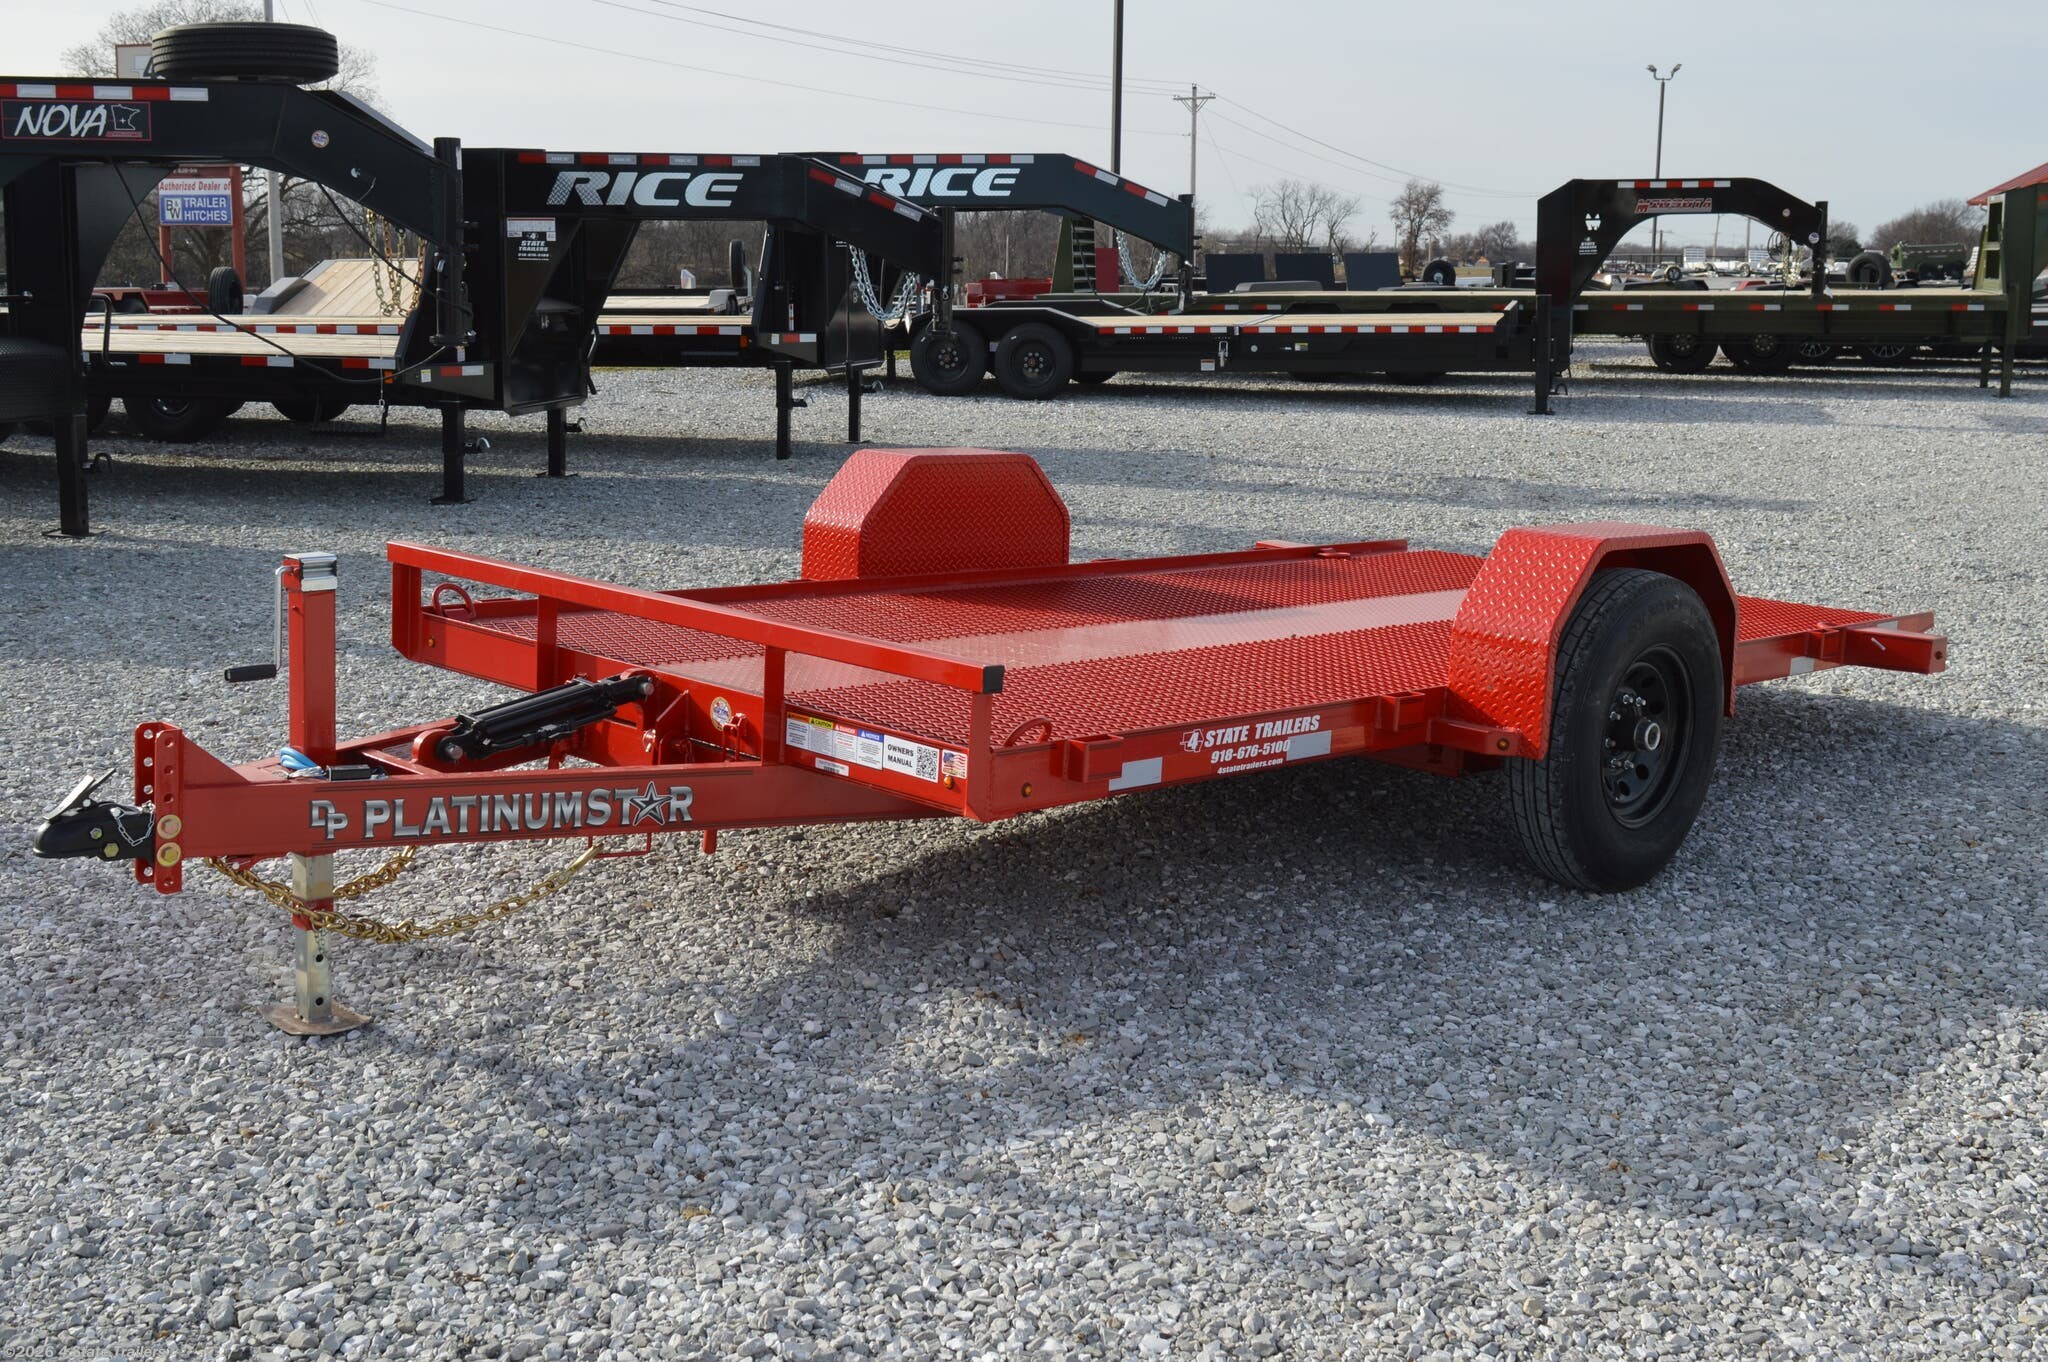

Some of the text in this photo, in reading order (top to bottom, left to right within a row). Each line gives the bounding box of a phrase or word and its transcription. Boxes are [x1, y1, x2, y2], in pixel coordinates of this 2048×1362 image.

[14, 104, 107, 137] NOVA
[160, 181, 231, 191] Authorized Dealer of
[546, 171, 744, 207] RICE
[863, 168, 1021, 197] RICE
[183, 197, 227, 208] TRAILER
[184, 210, 228, 221] HITCHES
[815, 719, 832, 729] CAUTION
[1204, 725, 1250, 748] STATE
[1255, 714, 1321, 740] TRAILERS
[887, 743, 914, 757] OWNERS
[1210, 739, 1291, 764] 918-676-5100
[887, 754, 913, 768] MANUAL
[1217, 757, 1284, 775] 4statetrailers.com
